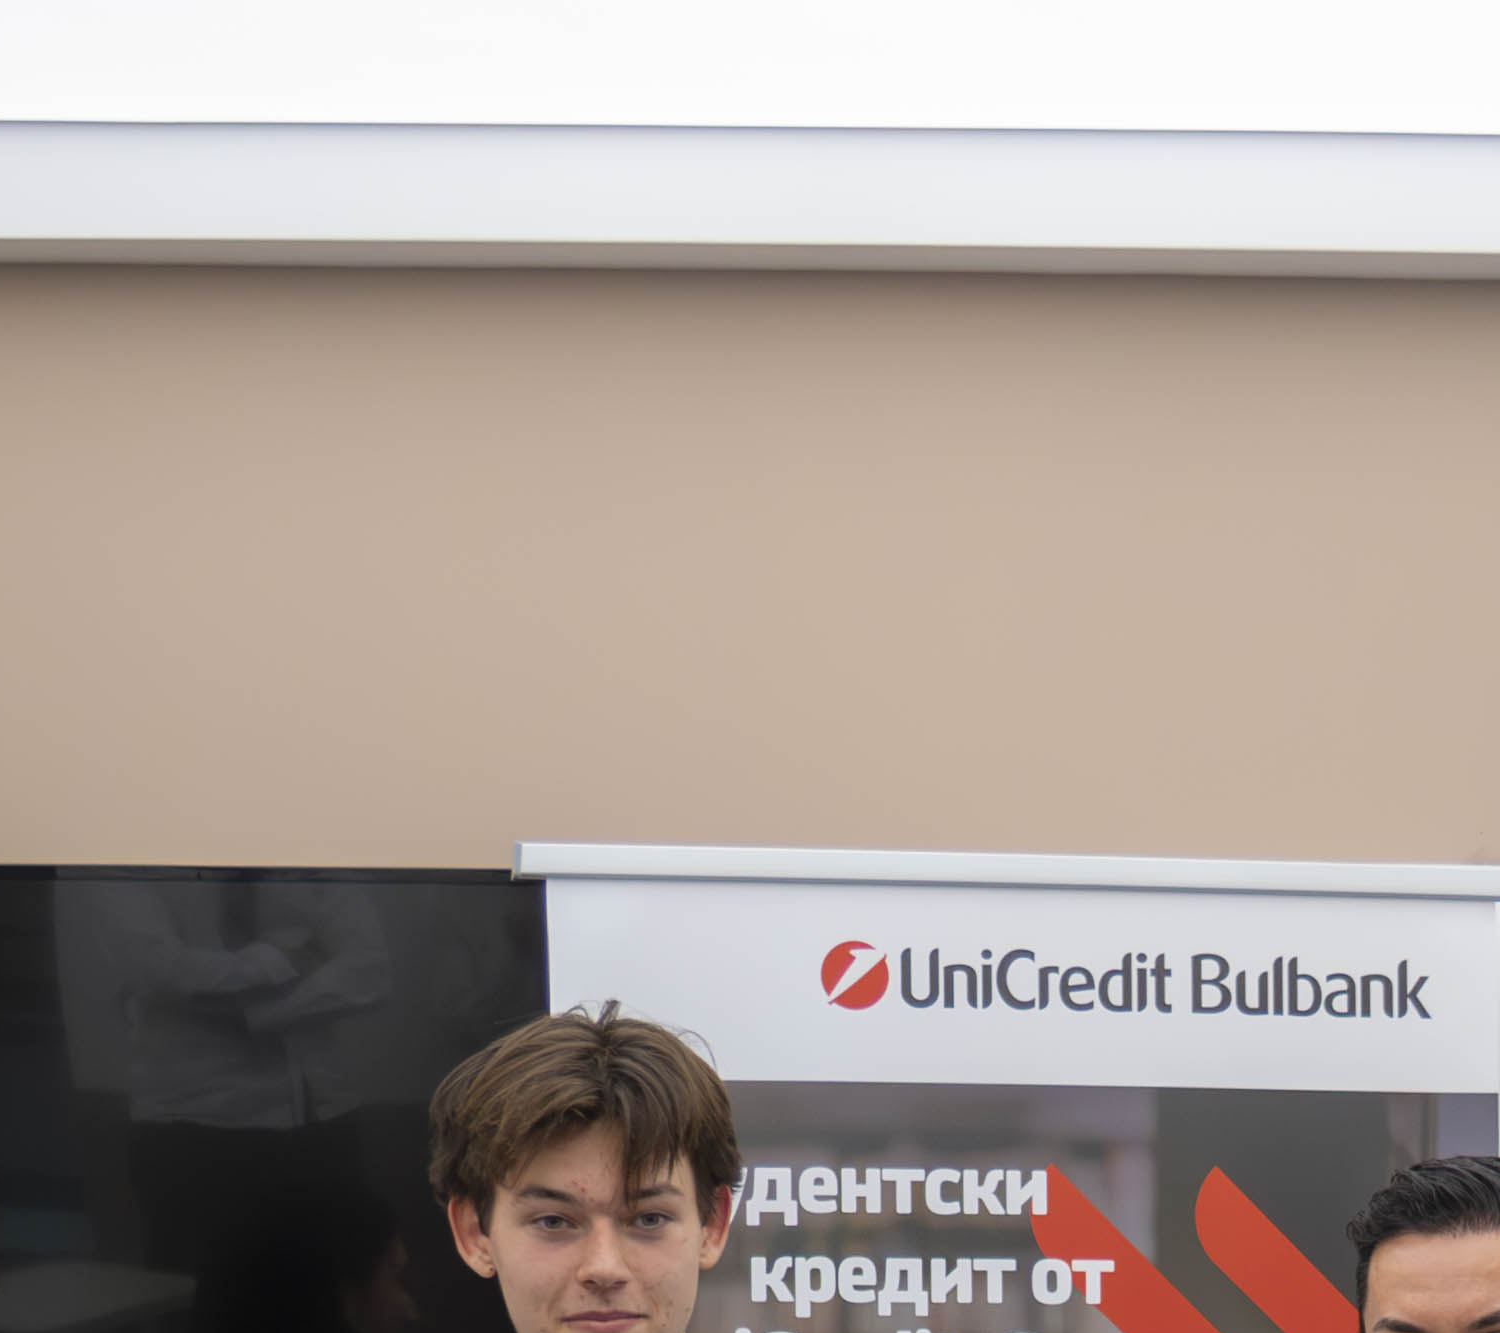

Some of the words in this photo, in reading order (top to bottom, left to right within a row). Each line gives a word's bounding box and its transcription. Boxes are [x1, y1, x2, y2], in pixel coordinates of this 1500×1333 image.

[900, 947, 1172, 1014] UniCredit
[1190, 952, 1432, 1019] Bulbank
[750, 1255, 1017, 1318] кредит
[1031, 1257, 1116, 1306] от
